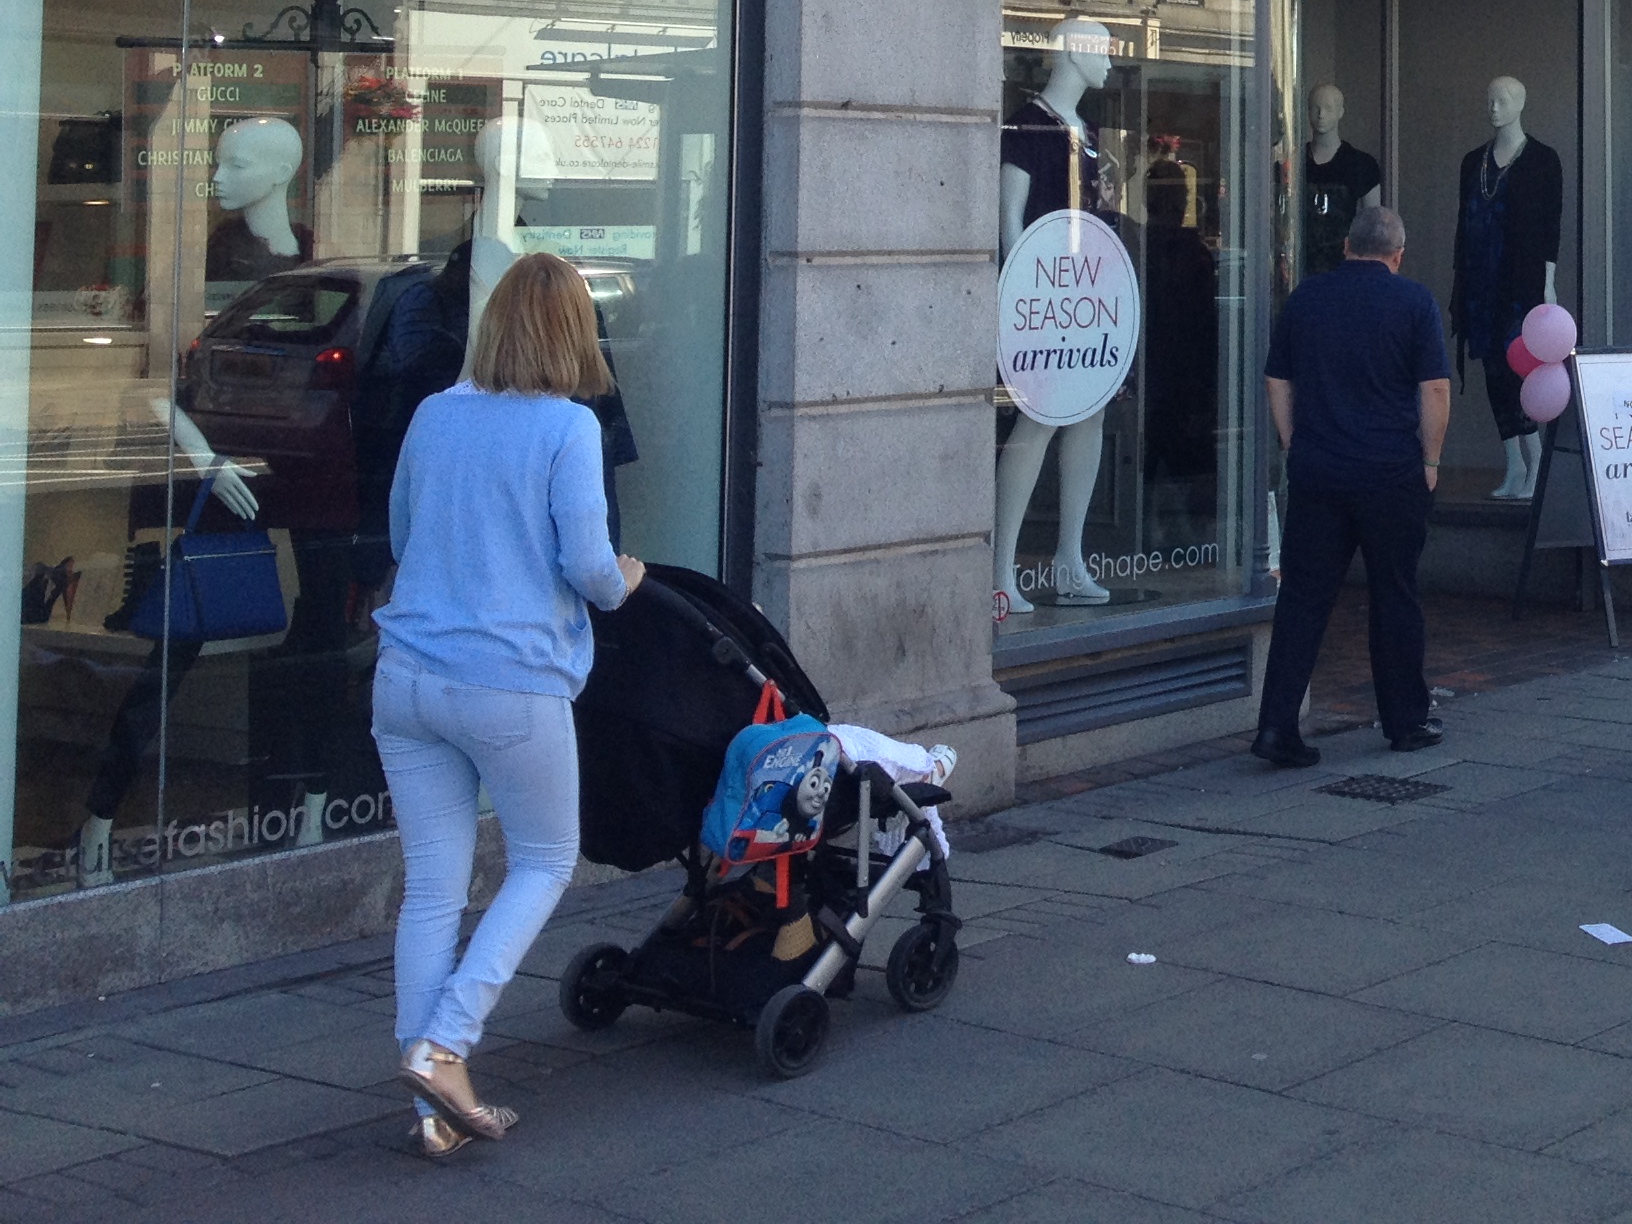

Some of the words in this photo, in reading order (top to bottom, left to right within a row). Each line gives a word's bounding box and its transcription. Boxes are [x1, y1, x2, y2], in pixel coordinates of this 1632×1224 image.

[172, 63, 247, 77] PATFORM
[253, 63, 264, 78] 2
[386, 67, 450, 80] PLATFORM
[197, 86, 240, 102] GUCCI
[355, 118, 430, 133] ALEXANDER
[138, 150, 213, 166] CHRISTIAN
[387, 148, 463, 163] BALENCIAGA
[392, 178, 459, 193] MULBERRY
[1035, 255, 1102, 290] NEW
[1013, 295, 1119, 332] SEASON
[1011, 332, 1120, 373] arrivals
[762, 754, 803, 769] ENGINE
